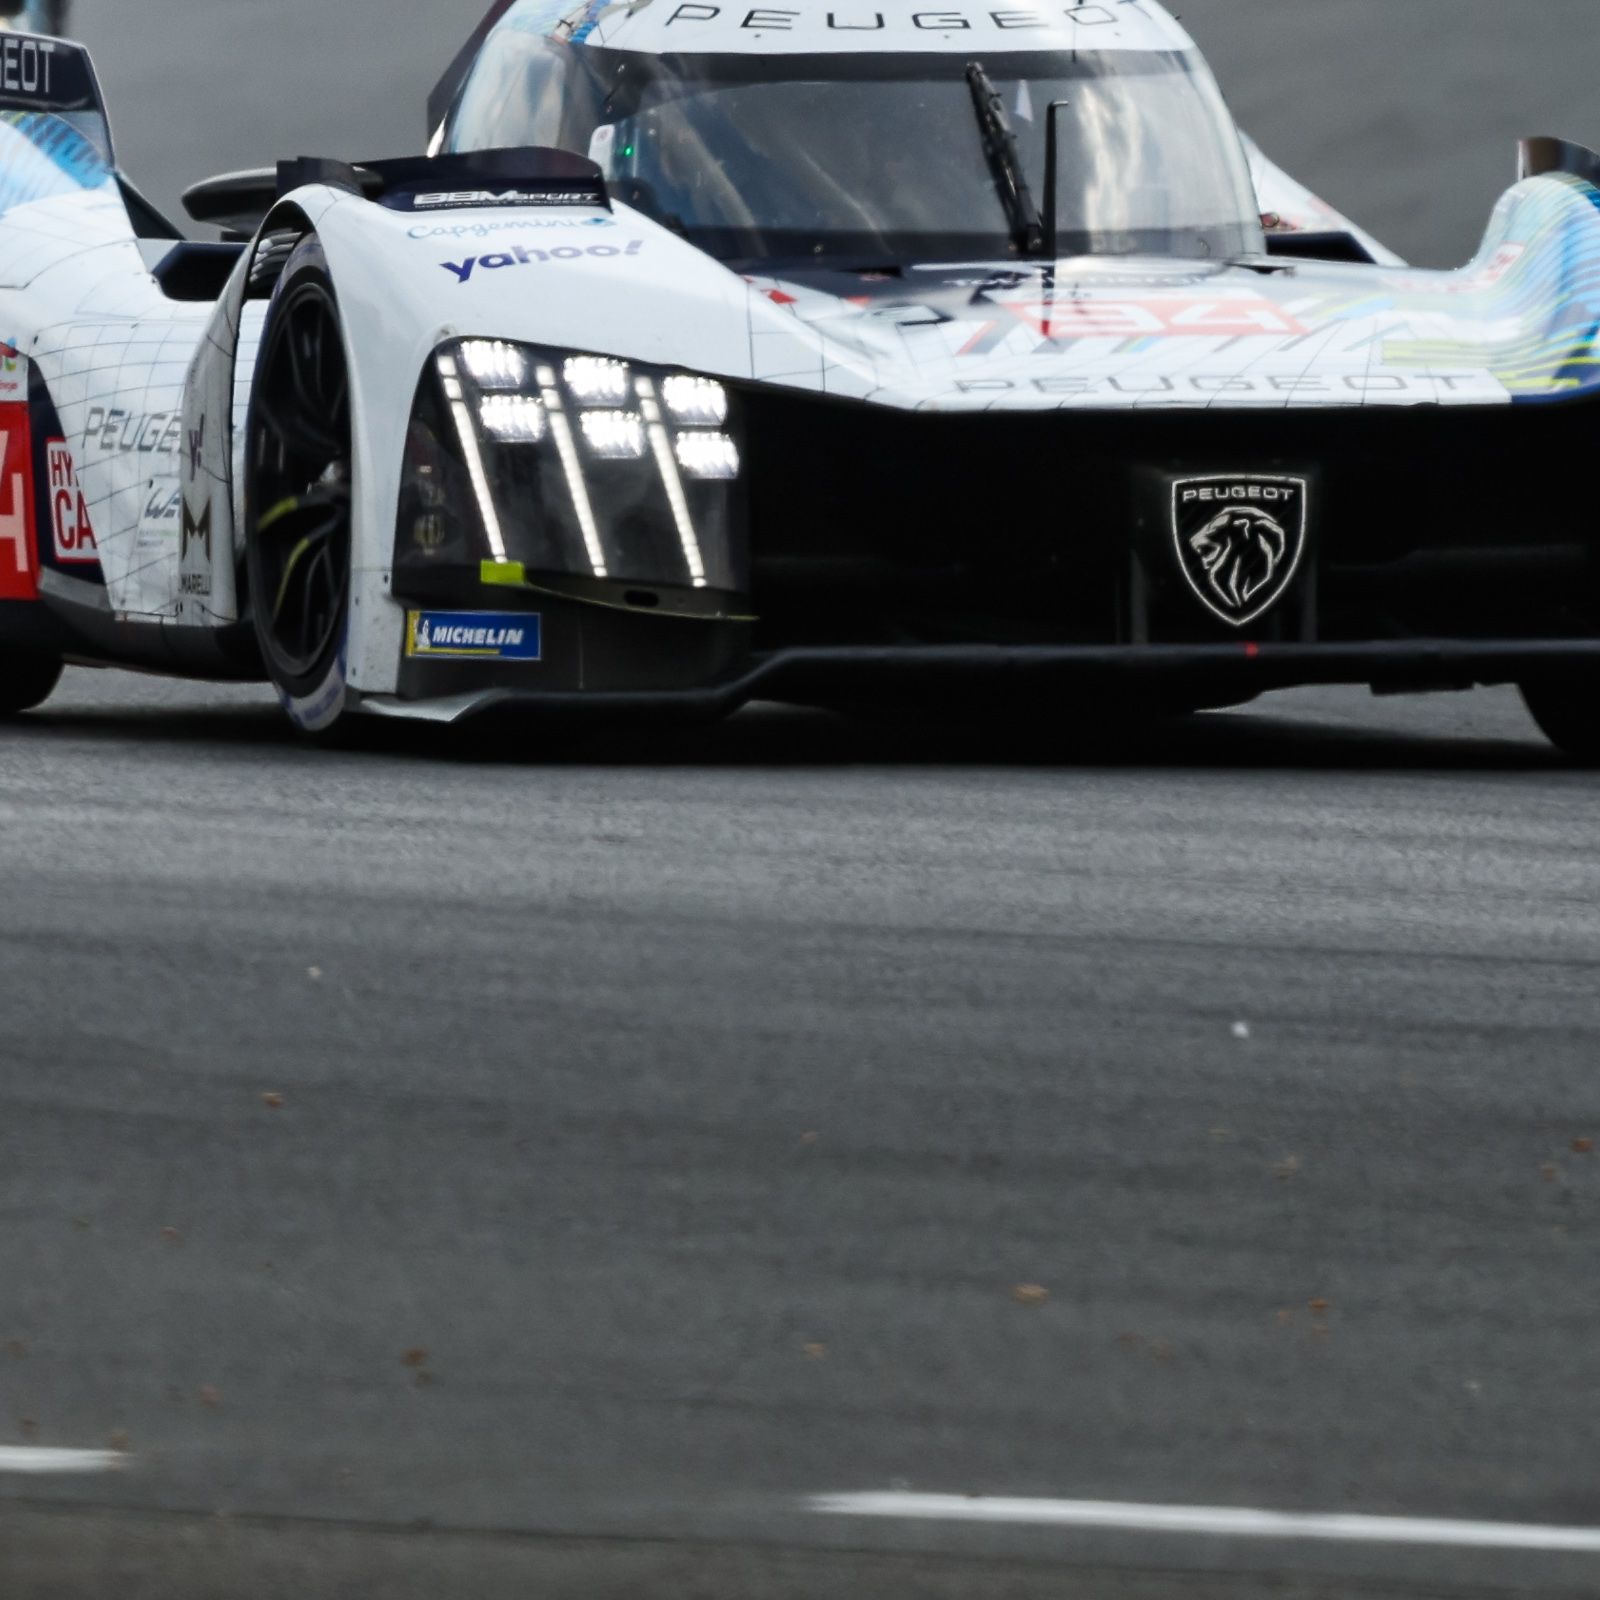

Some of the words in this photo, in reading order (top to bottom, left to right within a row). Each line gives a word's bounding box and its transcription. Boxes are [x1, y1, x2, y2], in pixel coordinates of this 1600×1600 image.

[407, 217, 579, 239] Capgemini
[439, 239, 644, 283] yahoo!
[952, 374, 1477, 394] PEUGEOT
[82, 407, 183, 452] PEUGE
[51, 450, 79, 487] HY
[1183, 485, 1294, 502] PEUGEOT
[432, 626, 524, 645] MICHELIN
